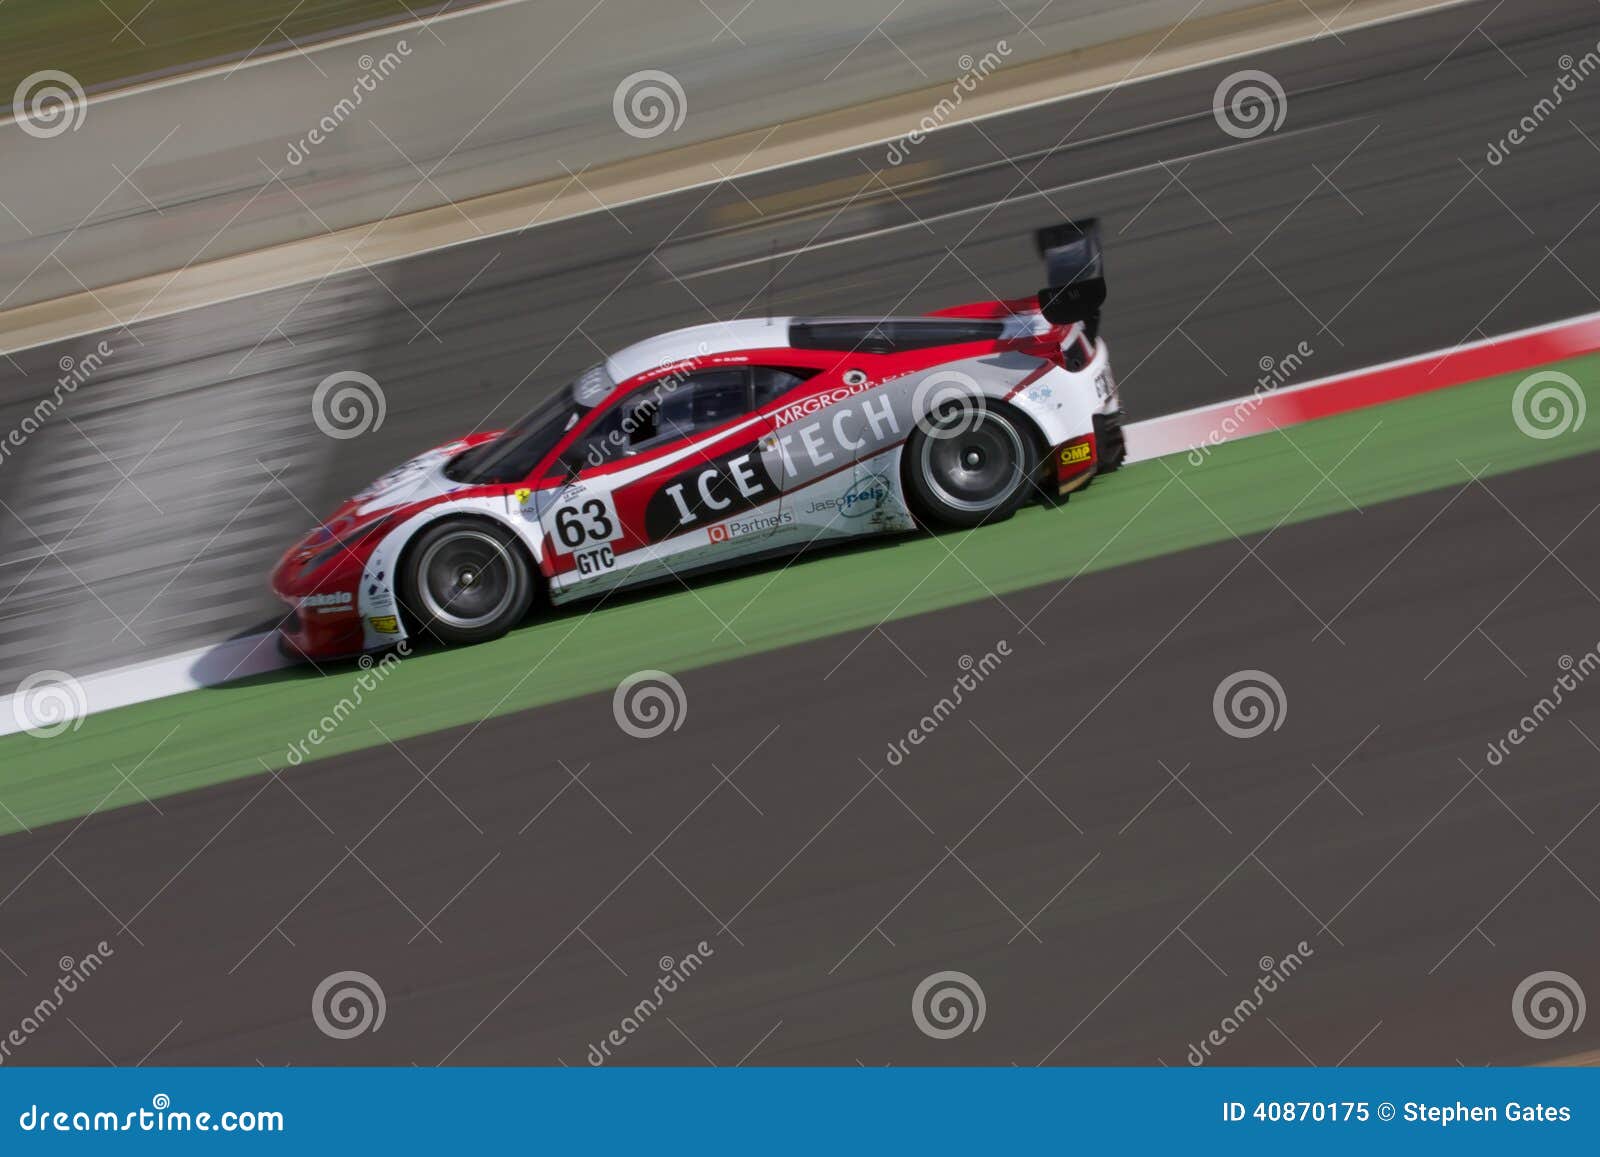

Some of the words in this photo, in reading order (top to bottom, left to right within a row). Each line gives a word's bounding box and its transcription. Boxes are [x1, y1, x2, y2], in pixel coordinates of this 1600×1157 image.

[1060, 444, 1091, 462] OMP
[555, 498, 613, 548] 63
[729, 511, 793, 537] Partners
[576, 546, 616, 575] GTC
